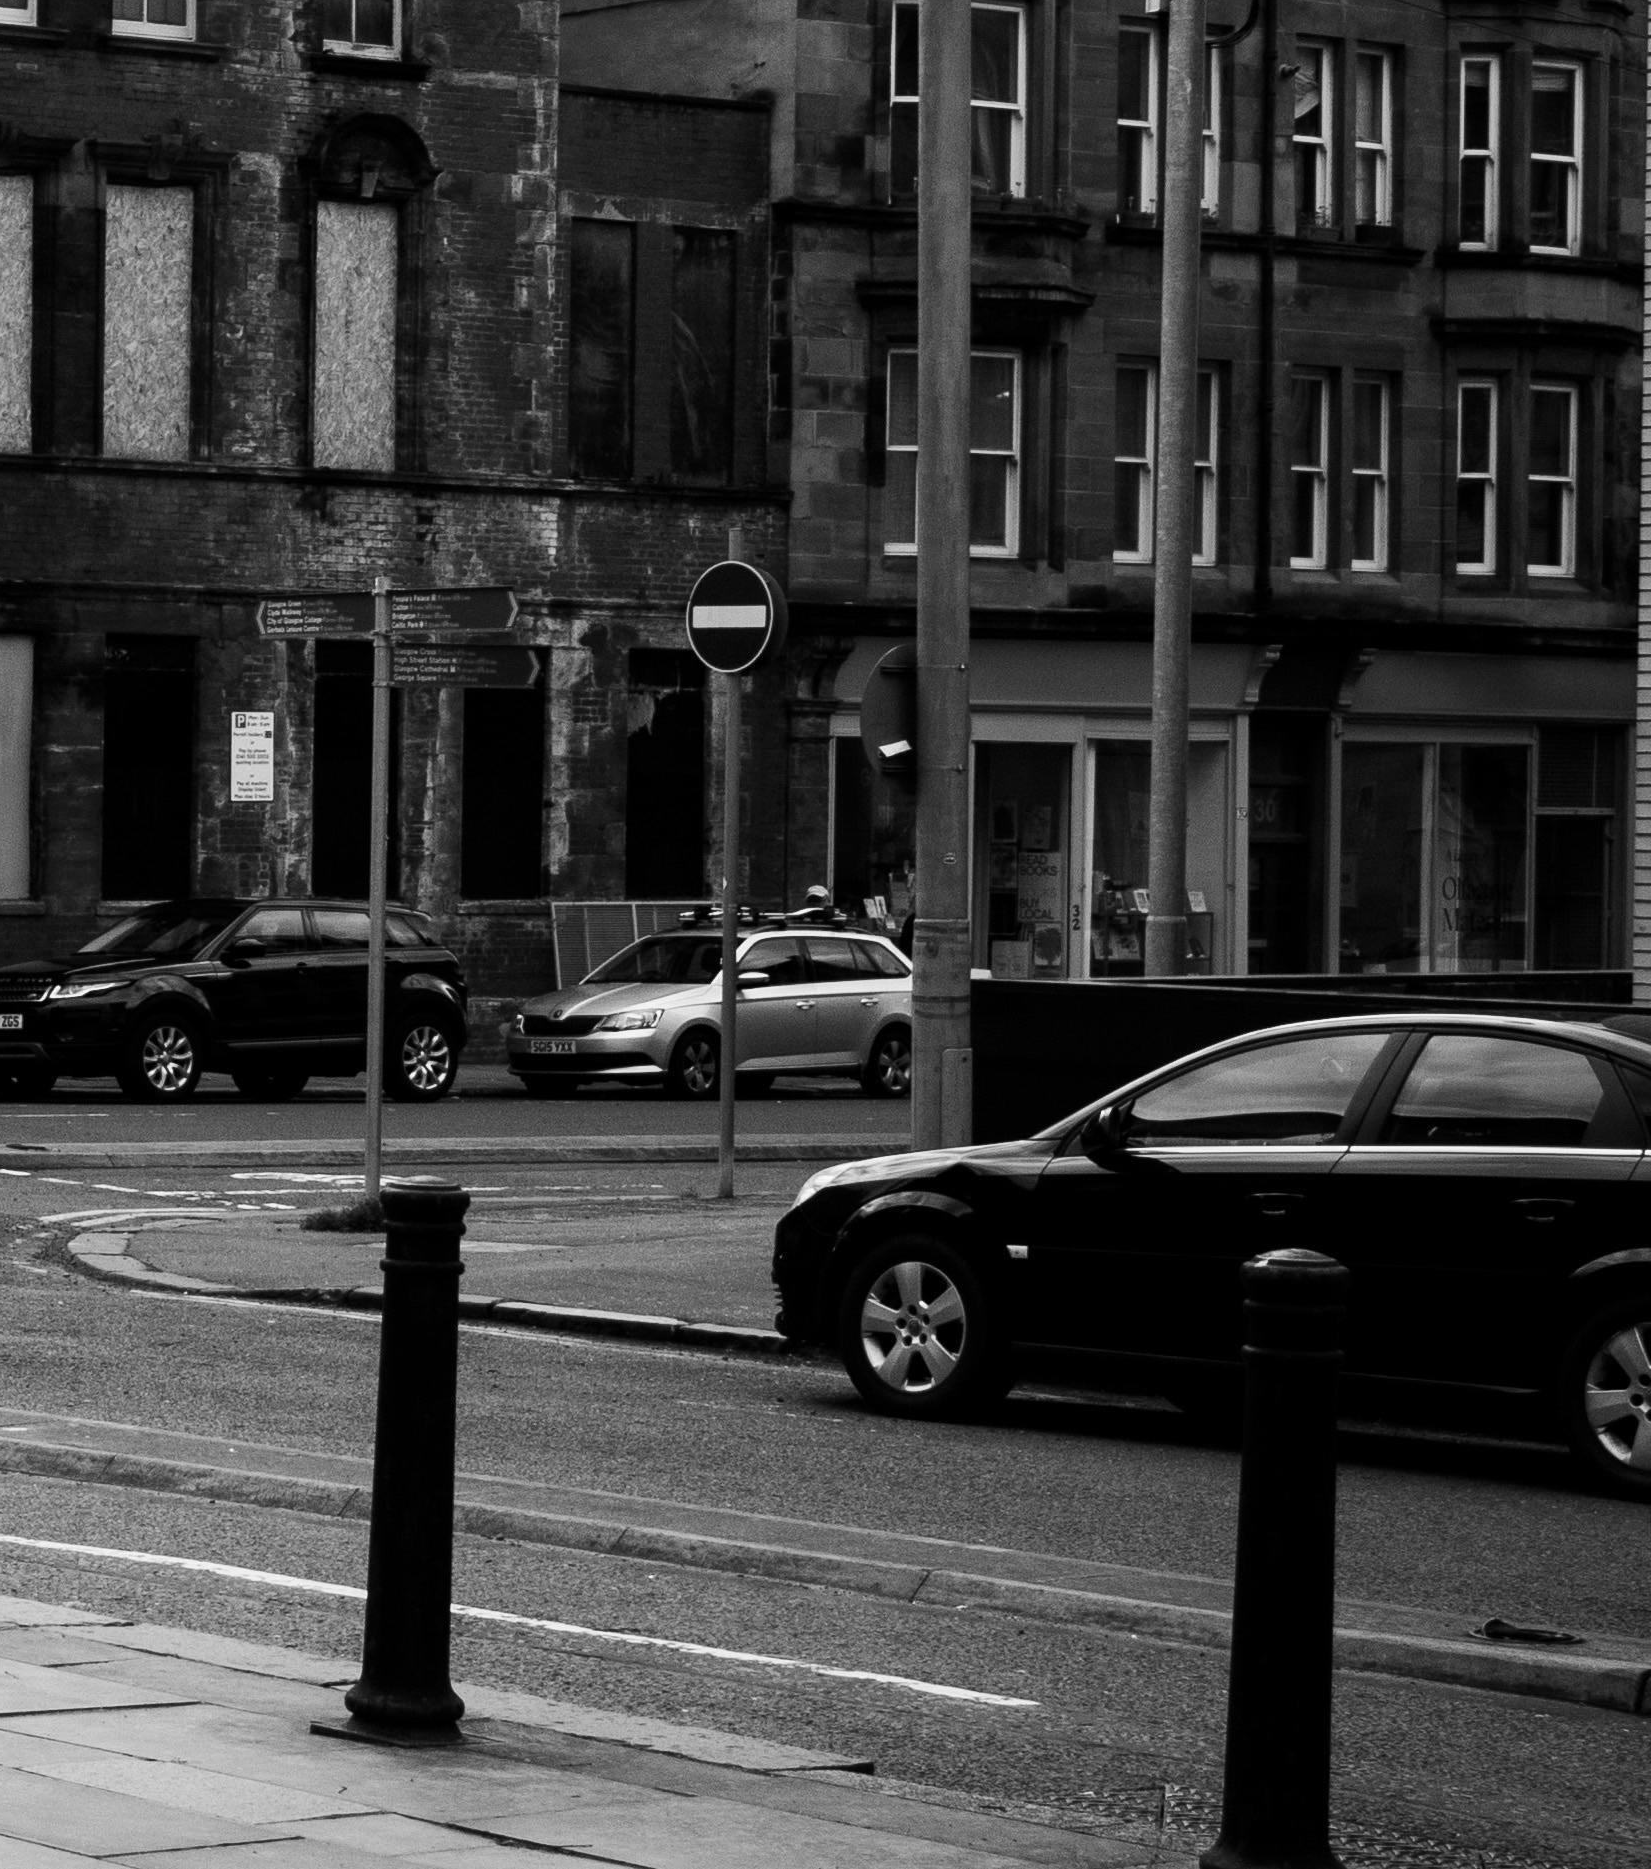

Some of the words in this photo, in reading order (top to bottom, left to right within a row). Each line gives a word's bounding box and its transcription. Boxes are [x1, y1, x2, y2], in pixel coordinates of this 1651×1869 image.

[1019, 866, 1058, 876] BOOKS
[1019, 898, 1039, 909] BUY
[1019, 909, 1054, 920] LOCAL
